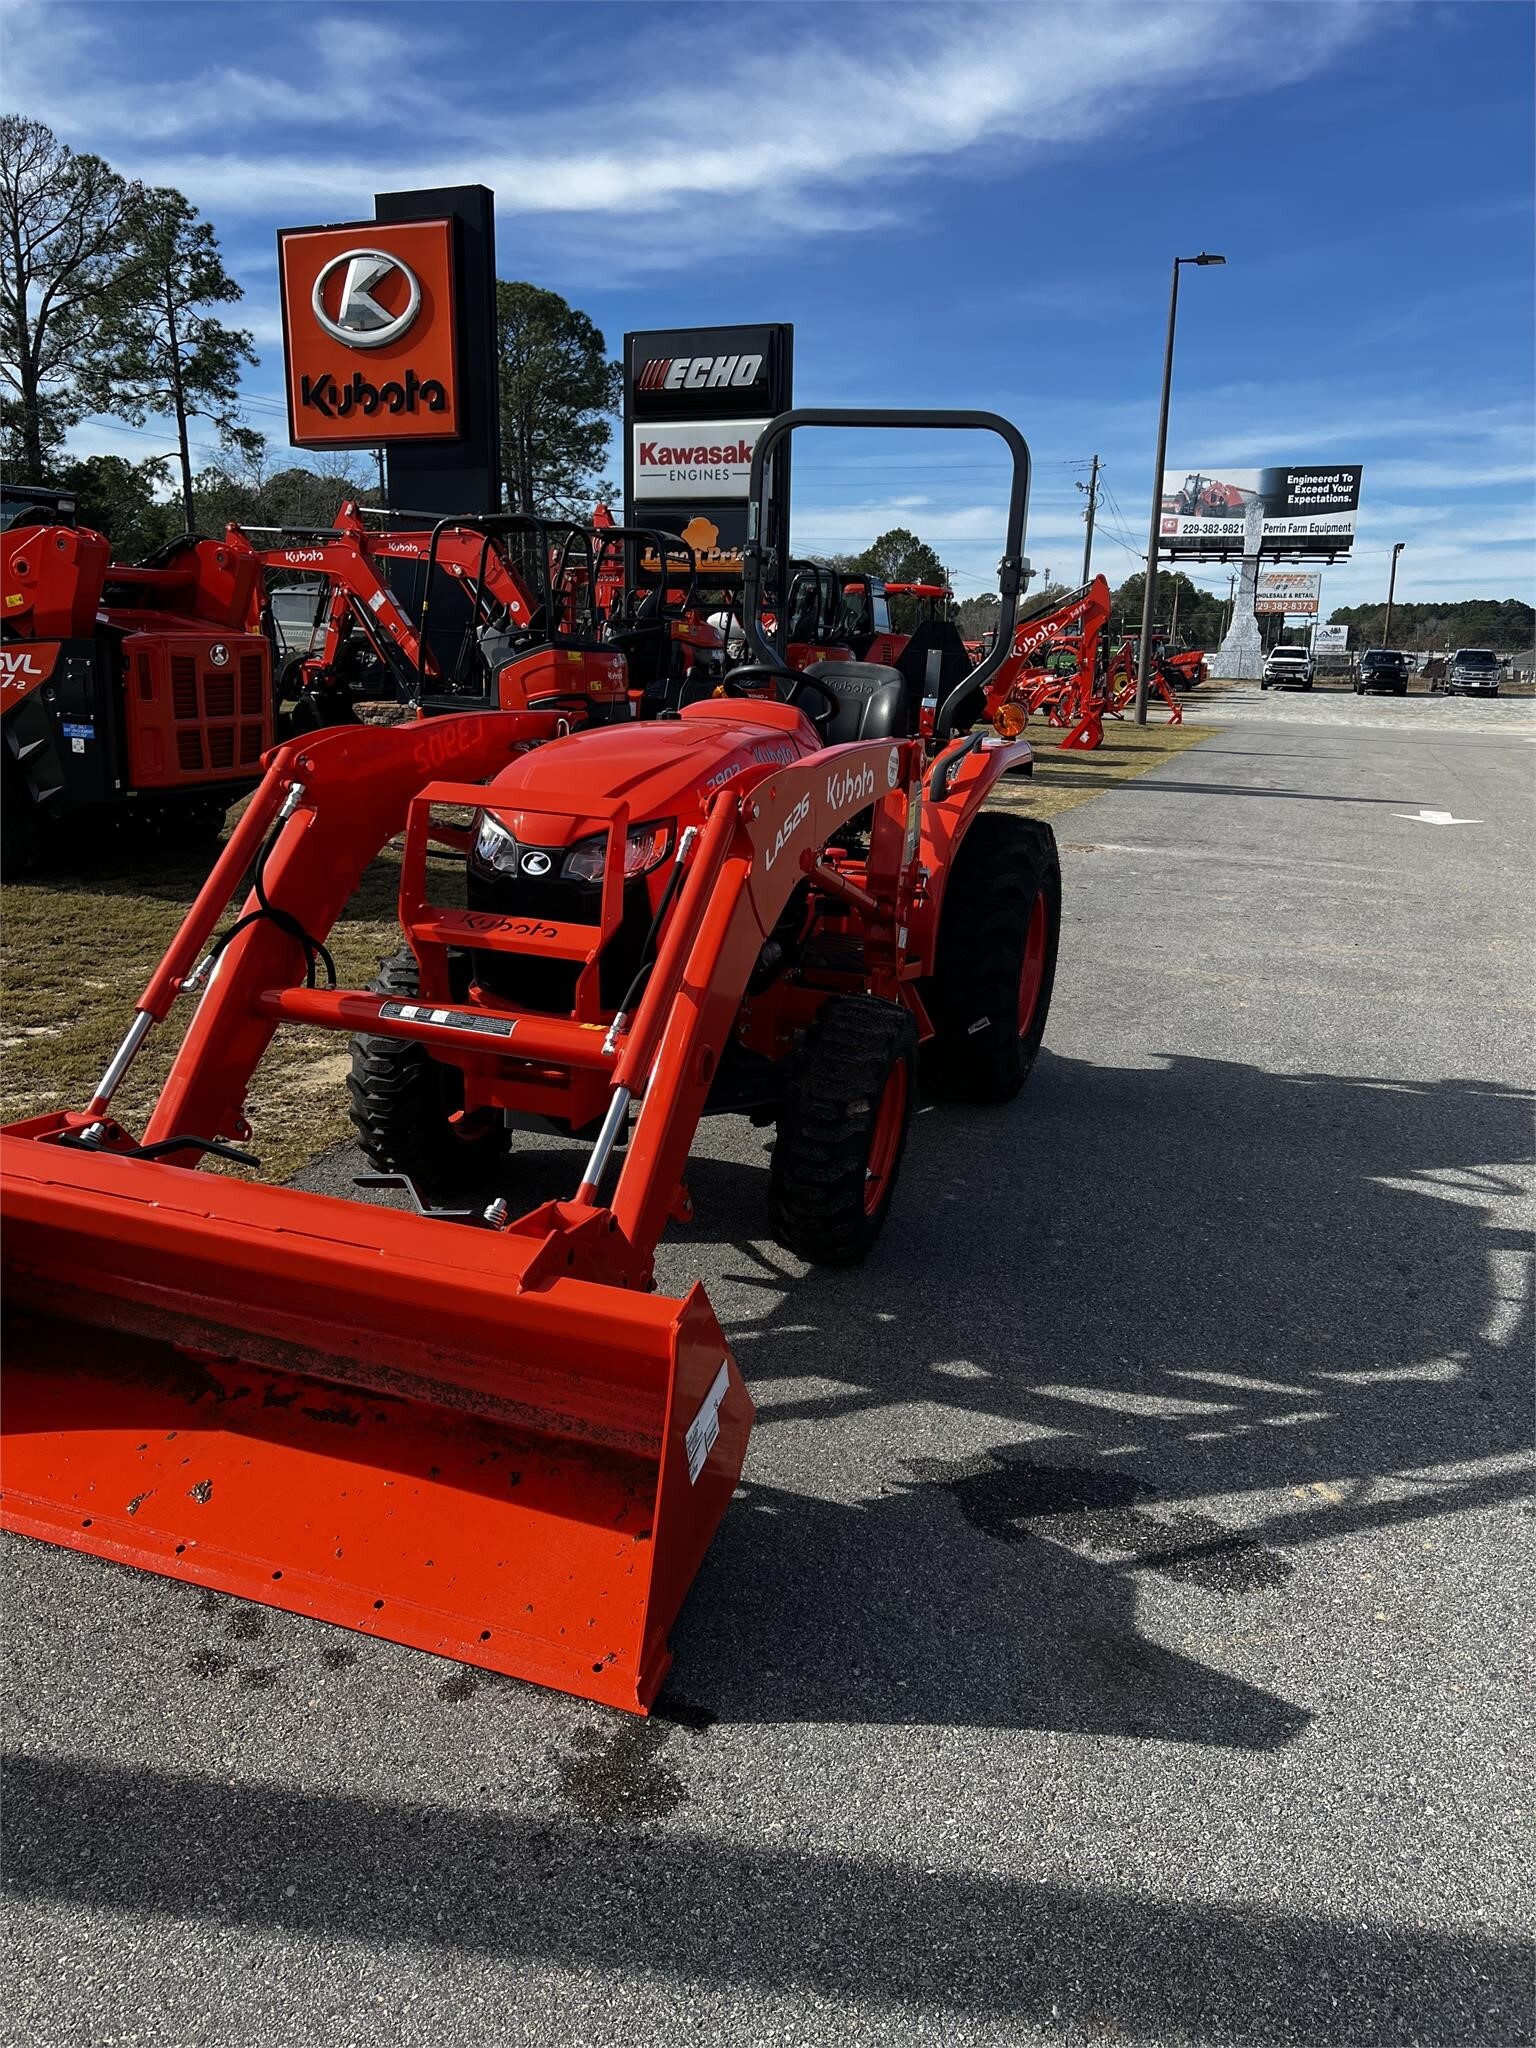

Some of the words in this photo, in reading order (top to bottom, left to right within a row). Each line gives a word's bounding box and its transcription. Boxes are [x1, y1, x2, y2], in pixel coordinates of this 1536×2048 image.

[663, 354, 763, 389] ECHO
[301, 368, 446, 416] Kubota
[640, 440, 754, 466] Kawasak
[669, 469, 730, 481] ENGINES
[1287, 474, 1339, 485] Engineered
[1341, 473, 1353, 482] To
[1295, 485, 1330, 494] Exceed
[1332, 484, 1353, 493] Your
[1288, 494, 1352, 505] Expectations.
[1182, 523, 1244, 534] 229-382-9821
[1263, 523, 1287, 533] Perrin
[1288, 523, 1308, 533] Farm
[1310, 522, 1351, 535] Equipment
[389, 542, 418, 552] Kubota
[285, 550, 323, 563] Kubota
[1256, 602, 1314, 610] 29-382-8373
[1010, 622, 1058, 658] Kubota
[753, 744, 795, 765] Kubota
[827, 762, 874, 810] Kubota
[765, 791, 810, 871] LA526
[461, 914, 558, 939] Kubota
